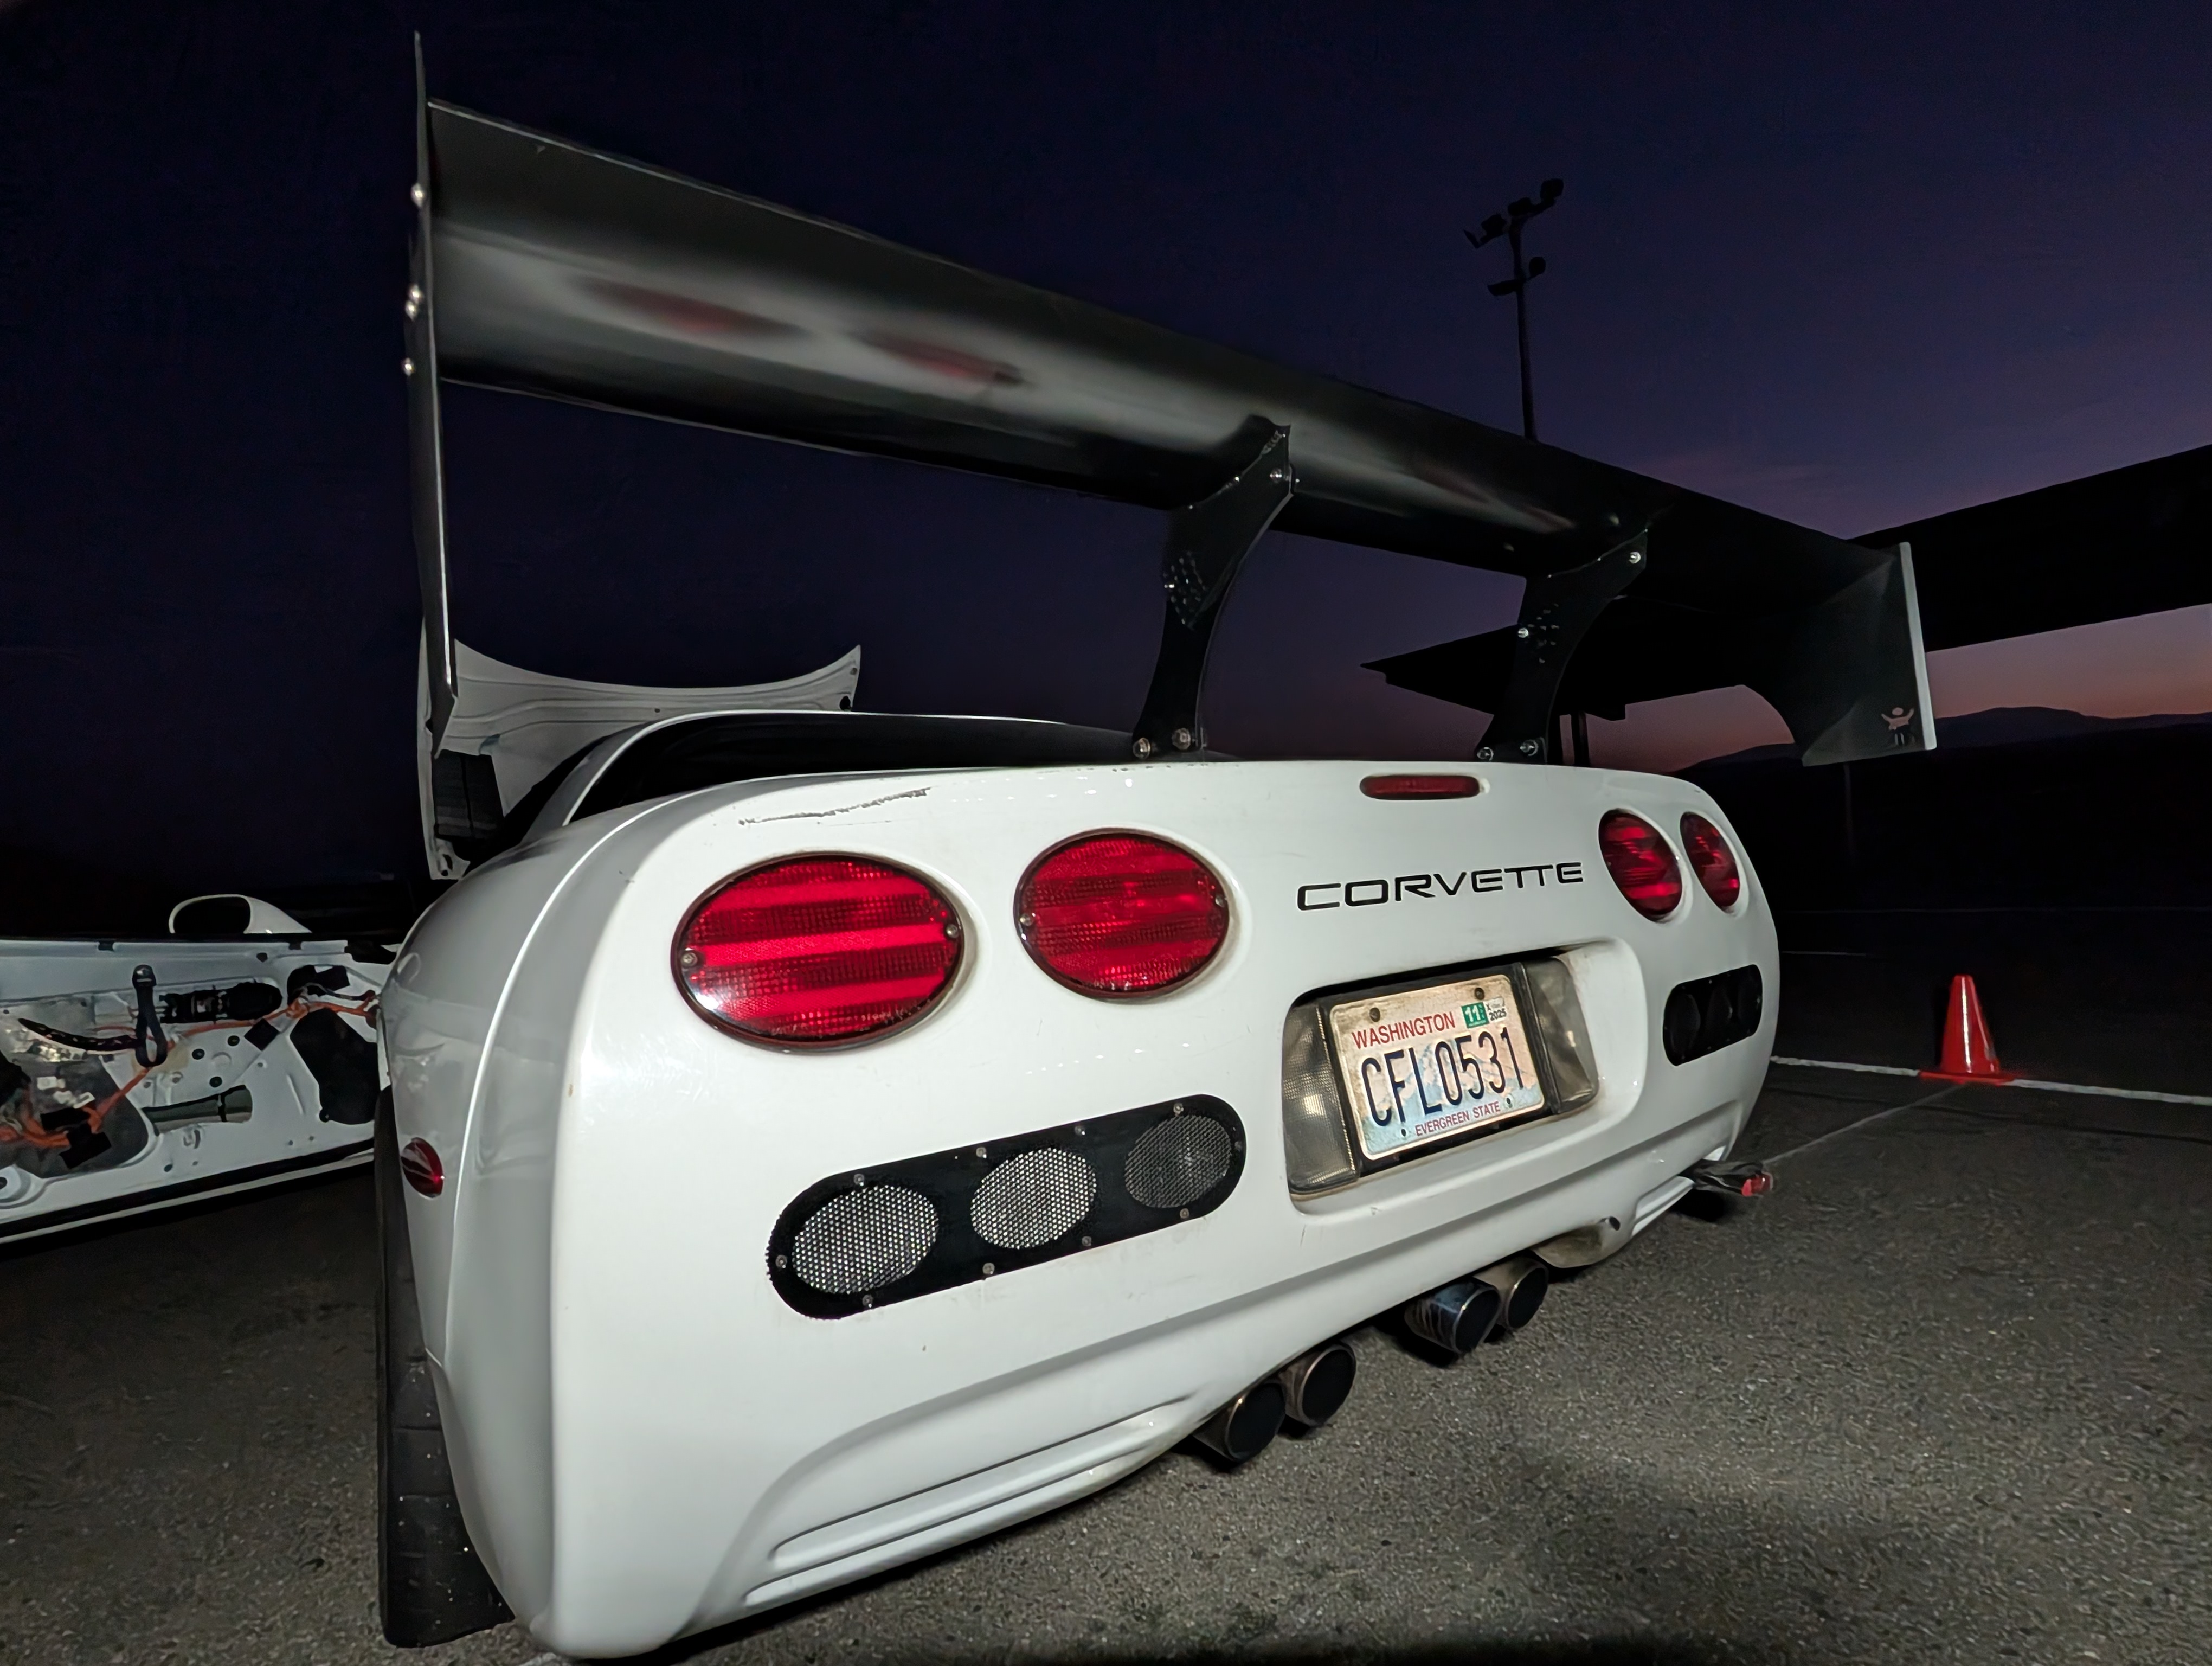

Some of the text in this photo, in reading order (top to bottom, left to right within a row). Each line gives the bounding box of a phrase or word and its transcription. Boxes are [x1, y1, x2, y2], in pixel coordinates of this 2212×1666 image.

[1297, 862, 1583, 911] CORVETTE
[1352, 1011, 1455, 1049] WASHINGTON
[1465, 1005, 1481, 1022] 11
[1361, 1027, 1524, 1127] CFL0531
[1415, 1101, 1501, 1136] EVERGREEN STATE
